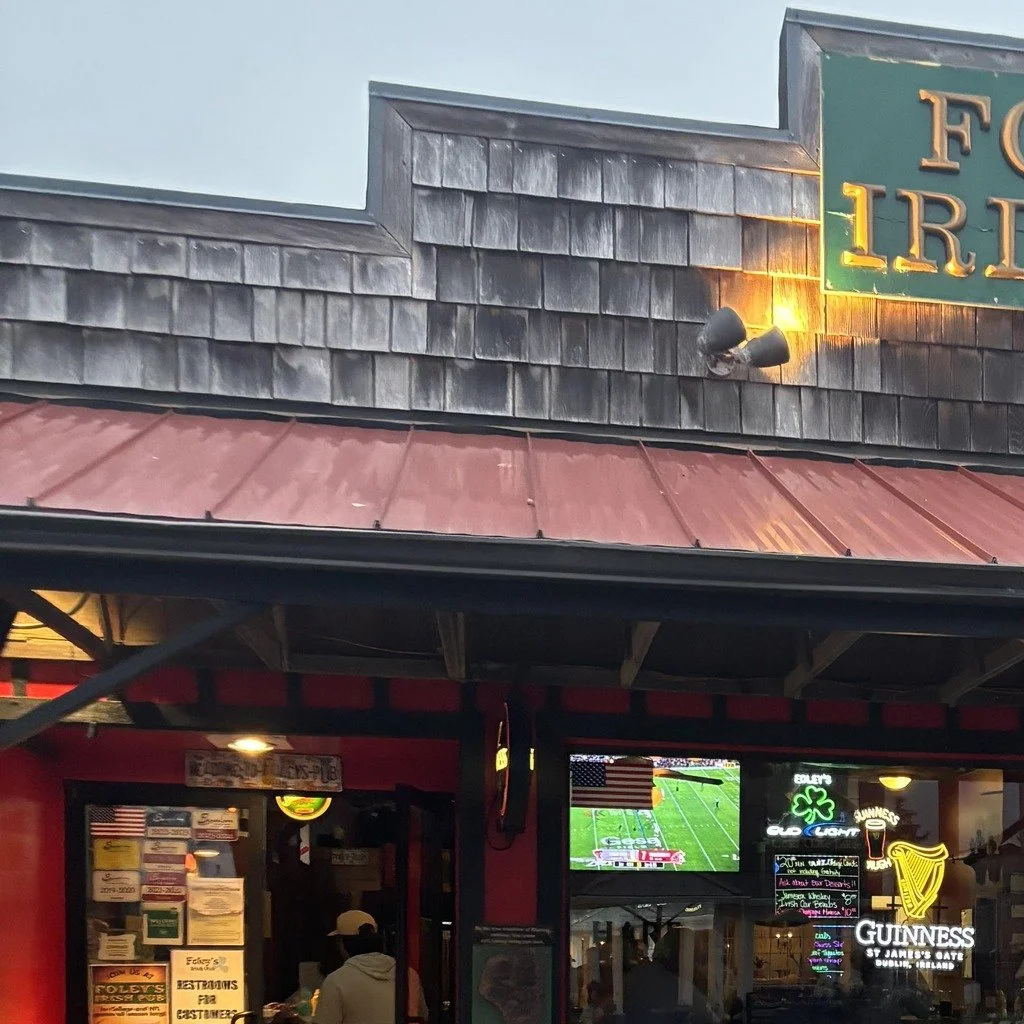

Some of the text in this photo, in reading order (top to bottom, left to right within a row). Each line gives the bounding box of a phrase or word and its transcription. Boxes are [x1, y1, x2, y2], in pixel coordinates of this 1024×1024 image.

[854, 806, 900, 826] GUINNESS
[767, 826, 860, 836] BUD LIGHT
[856, 920, 975, 948] GUINNESS
[866, 948, 964, 961] ST JAMES'S GATE
[916, 961, 955, 970] IRELAND
[177, 980, 238, 990] RESTROOMS
[198, 995, 216, 1005] FOR
[177, 1009, 238, 1020] CUSTOMERS
